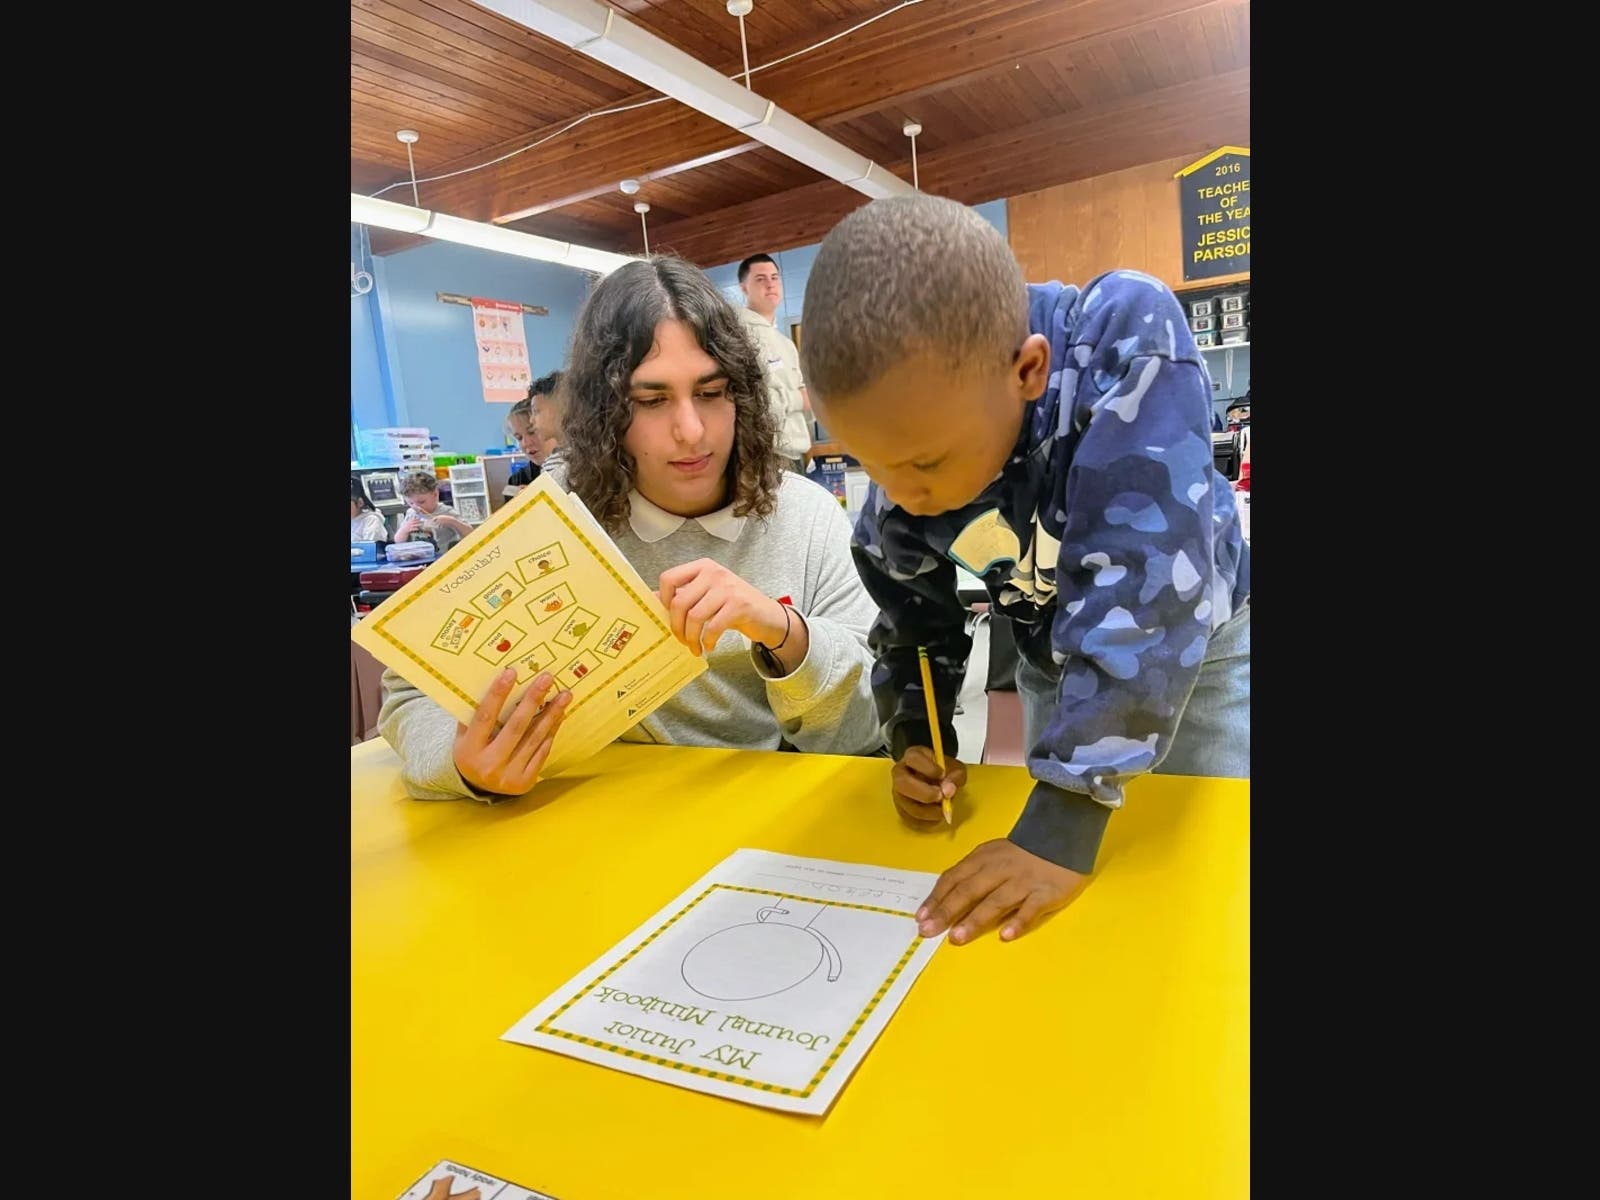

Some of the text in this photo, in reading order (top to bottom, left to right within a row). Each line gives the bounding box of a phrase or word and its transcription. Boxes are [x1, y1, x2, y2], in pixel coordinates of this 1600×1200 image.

[1215, 163, 1241, 176] 2016
[1220, 196, 1238, 208] OF
[1198, 212, 1223, 226] THE
[1193, 243, 1250, 263] PARSO
[439, 546, 502, 595] Vocabulary
[483, 583, 503, 600] goods
[440, 619, 456, 640] money
[595, 986, 830, 1051] Journal Minibook
[604, 1021, 695, 1055] Junior
